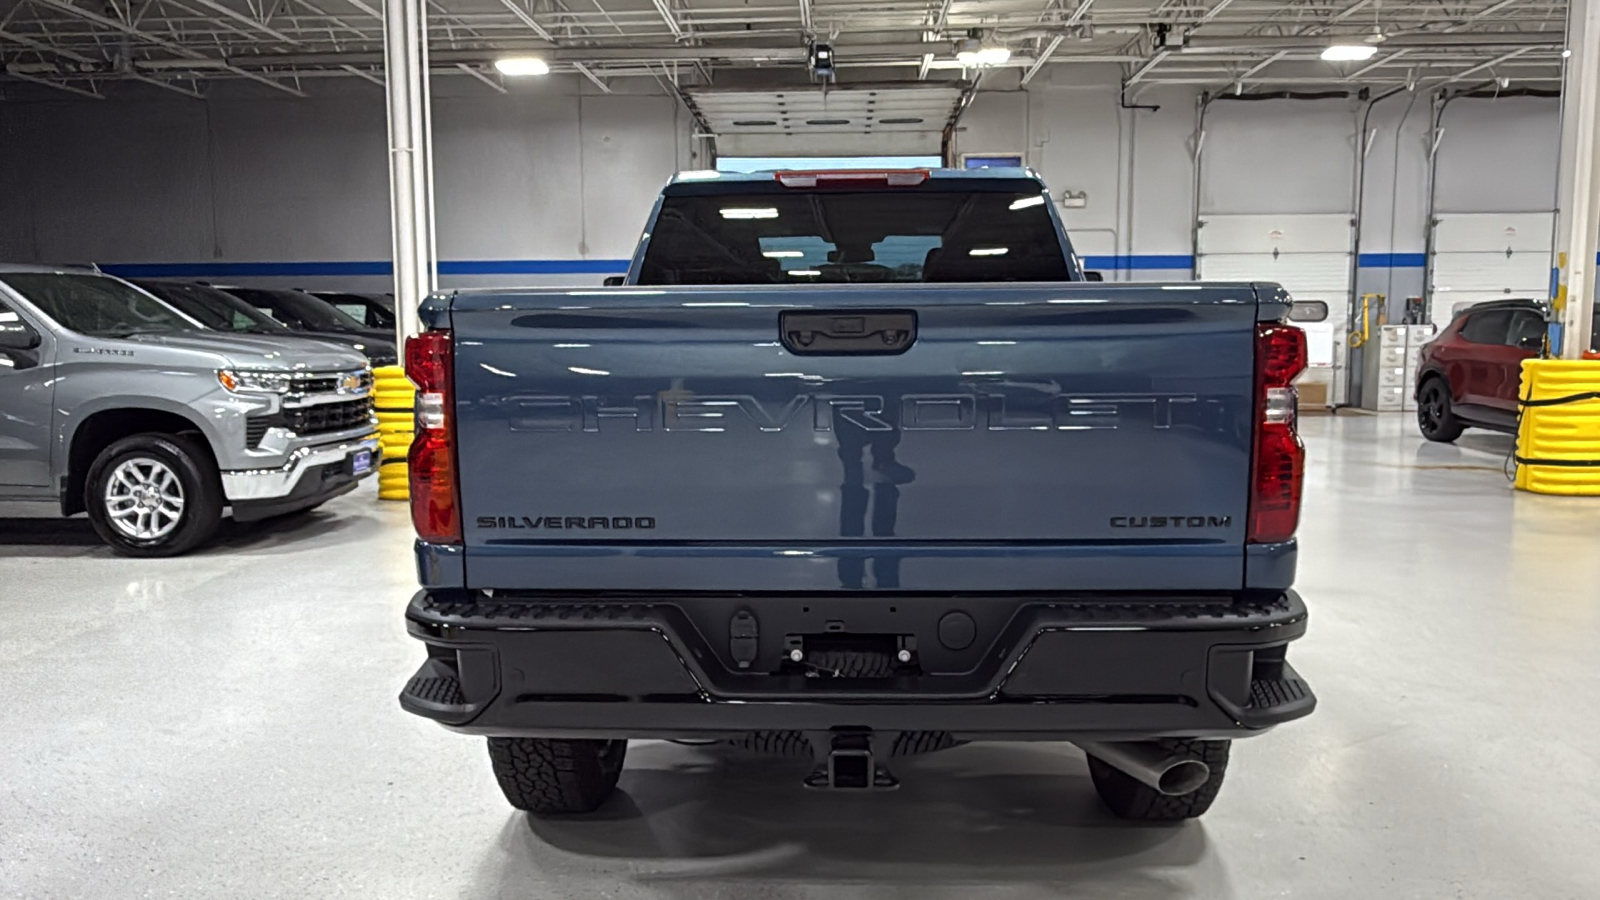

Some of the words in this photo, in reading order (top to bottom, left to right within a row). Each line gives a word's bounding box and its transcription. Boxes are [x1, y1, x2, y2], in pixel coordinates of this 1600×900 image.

[508, 394, 1197, 432] CHEVROLET
[476, 516, 656, 529] SILVERADO
[1110, 516, 1232, 528] CUSTOM
